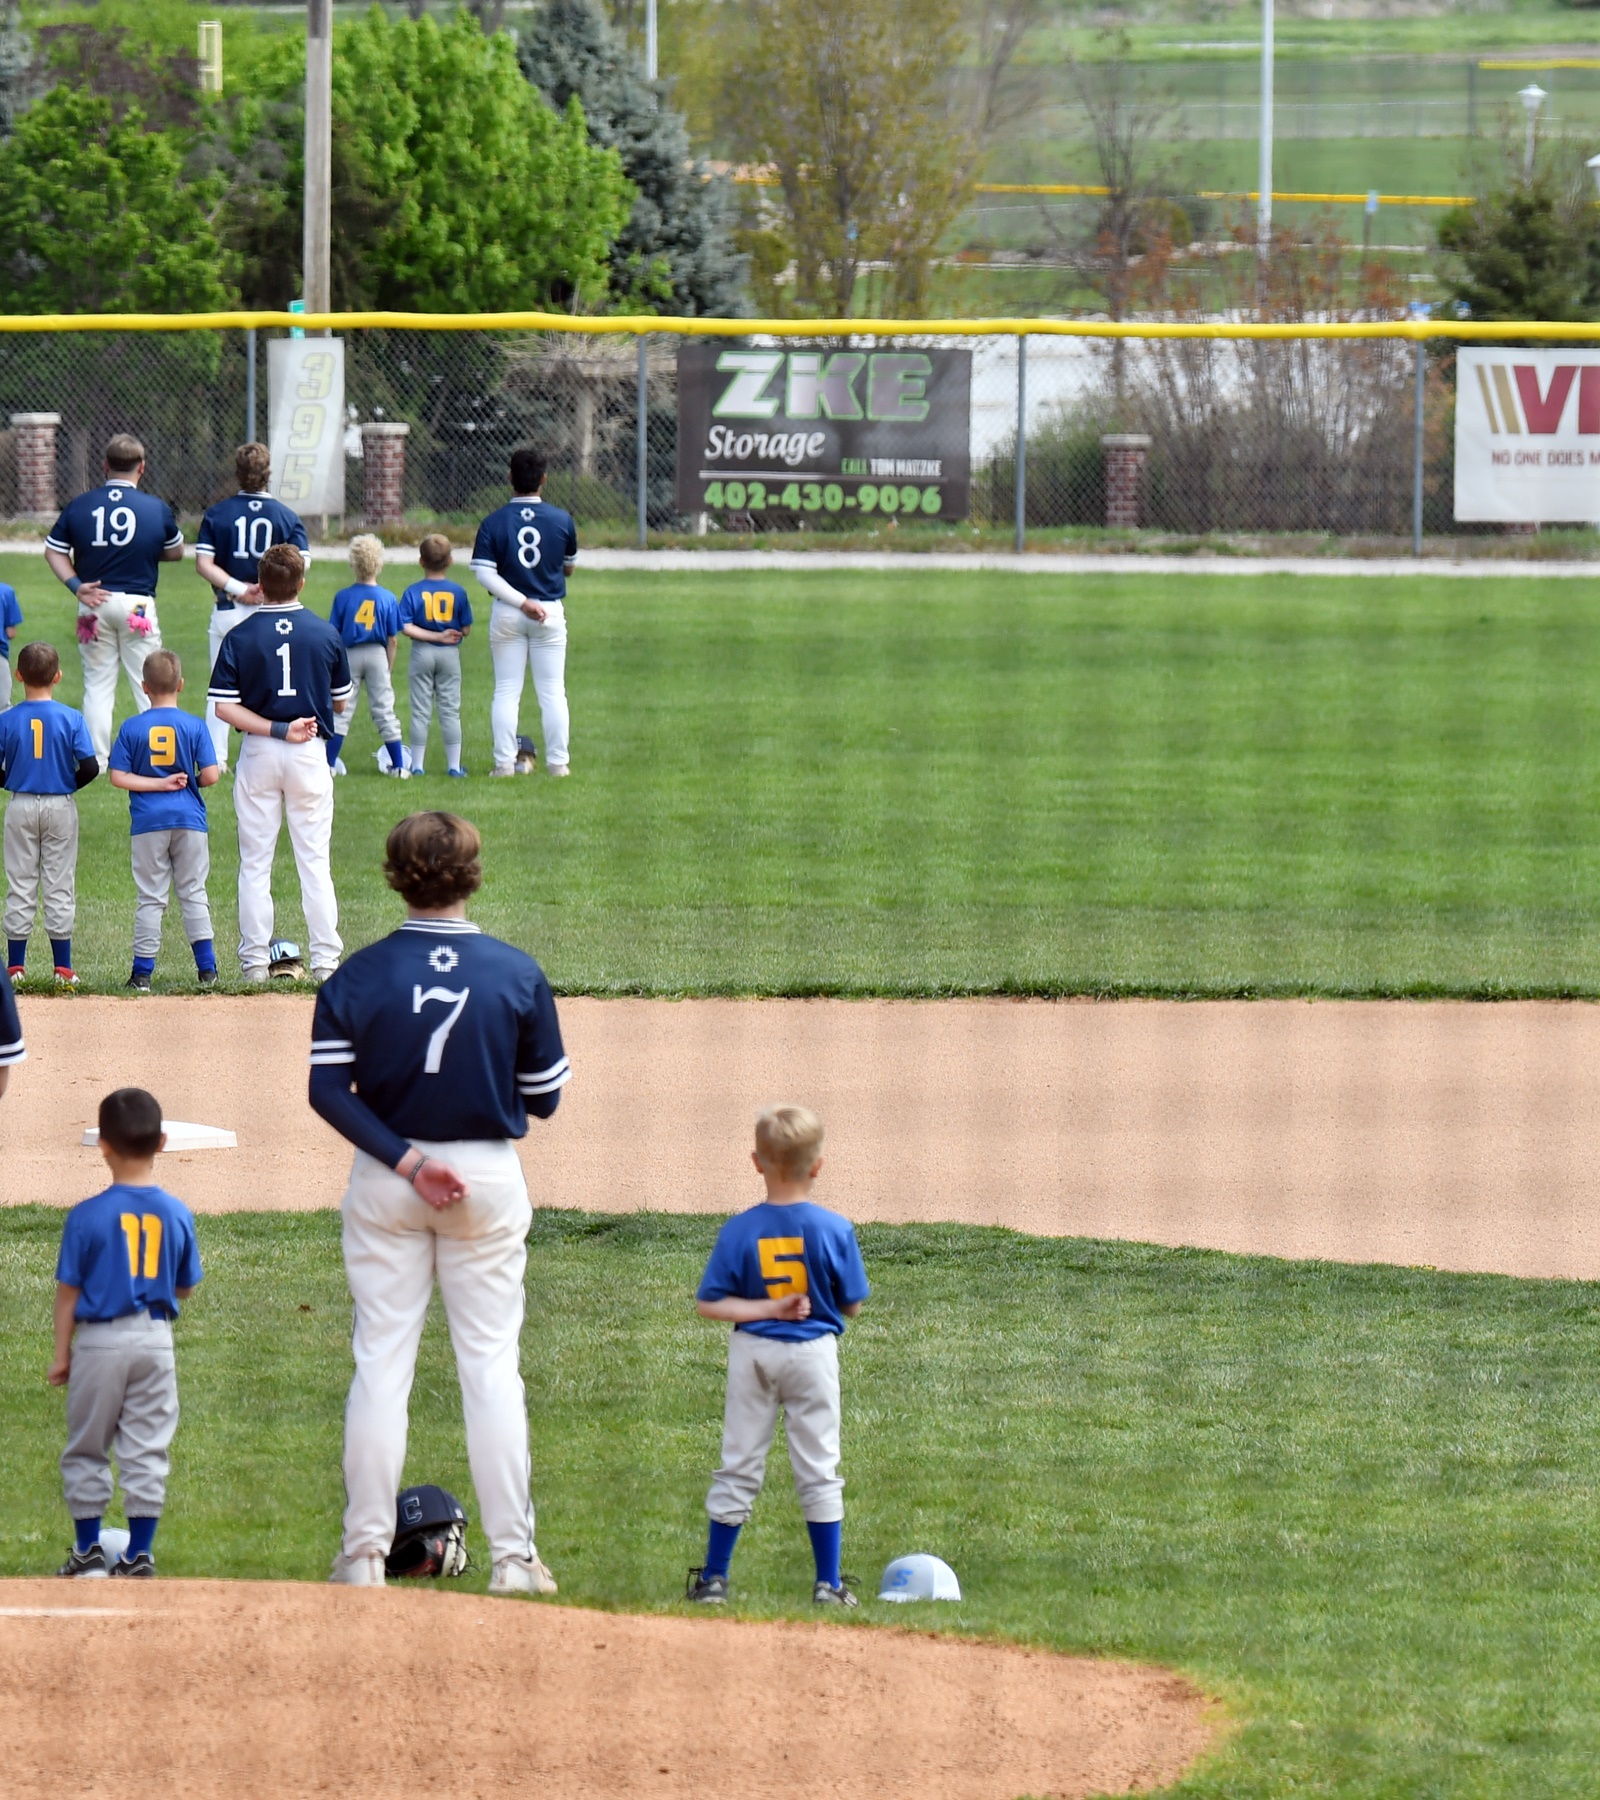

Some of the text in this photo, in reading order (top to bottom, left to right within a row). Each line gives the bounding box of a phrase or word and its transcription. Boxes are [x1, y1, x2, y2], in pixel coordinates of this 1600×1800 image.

[712, 351, 933, 422] ZKE
[704, 424, 825, 466] Storage
[1492, 450, 1512, 466] NO
[1547, 450, 1585, 466] DOES
[704, 481, 942, 514] 402-430-9096
[91, 506, 137, 547] 19
[233, 515, 273, 559] 10
[517, 525, 542, 569] 8
[354, 599, 376, 631] 4
[421, 591, 455, 623] 10
[276, 642, 297, 697] 1
[30, 718, 44, 759] 1
[148, 725, 176, 767] 9
[412, 984, 470, 1074] 7
[120, 1212, 163, 1279] 11
[757, 1236, 809, 1301] 5
[401, 1496, 423, 1525] C
[891, 1569, 914, 1588] S
